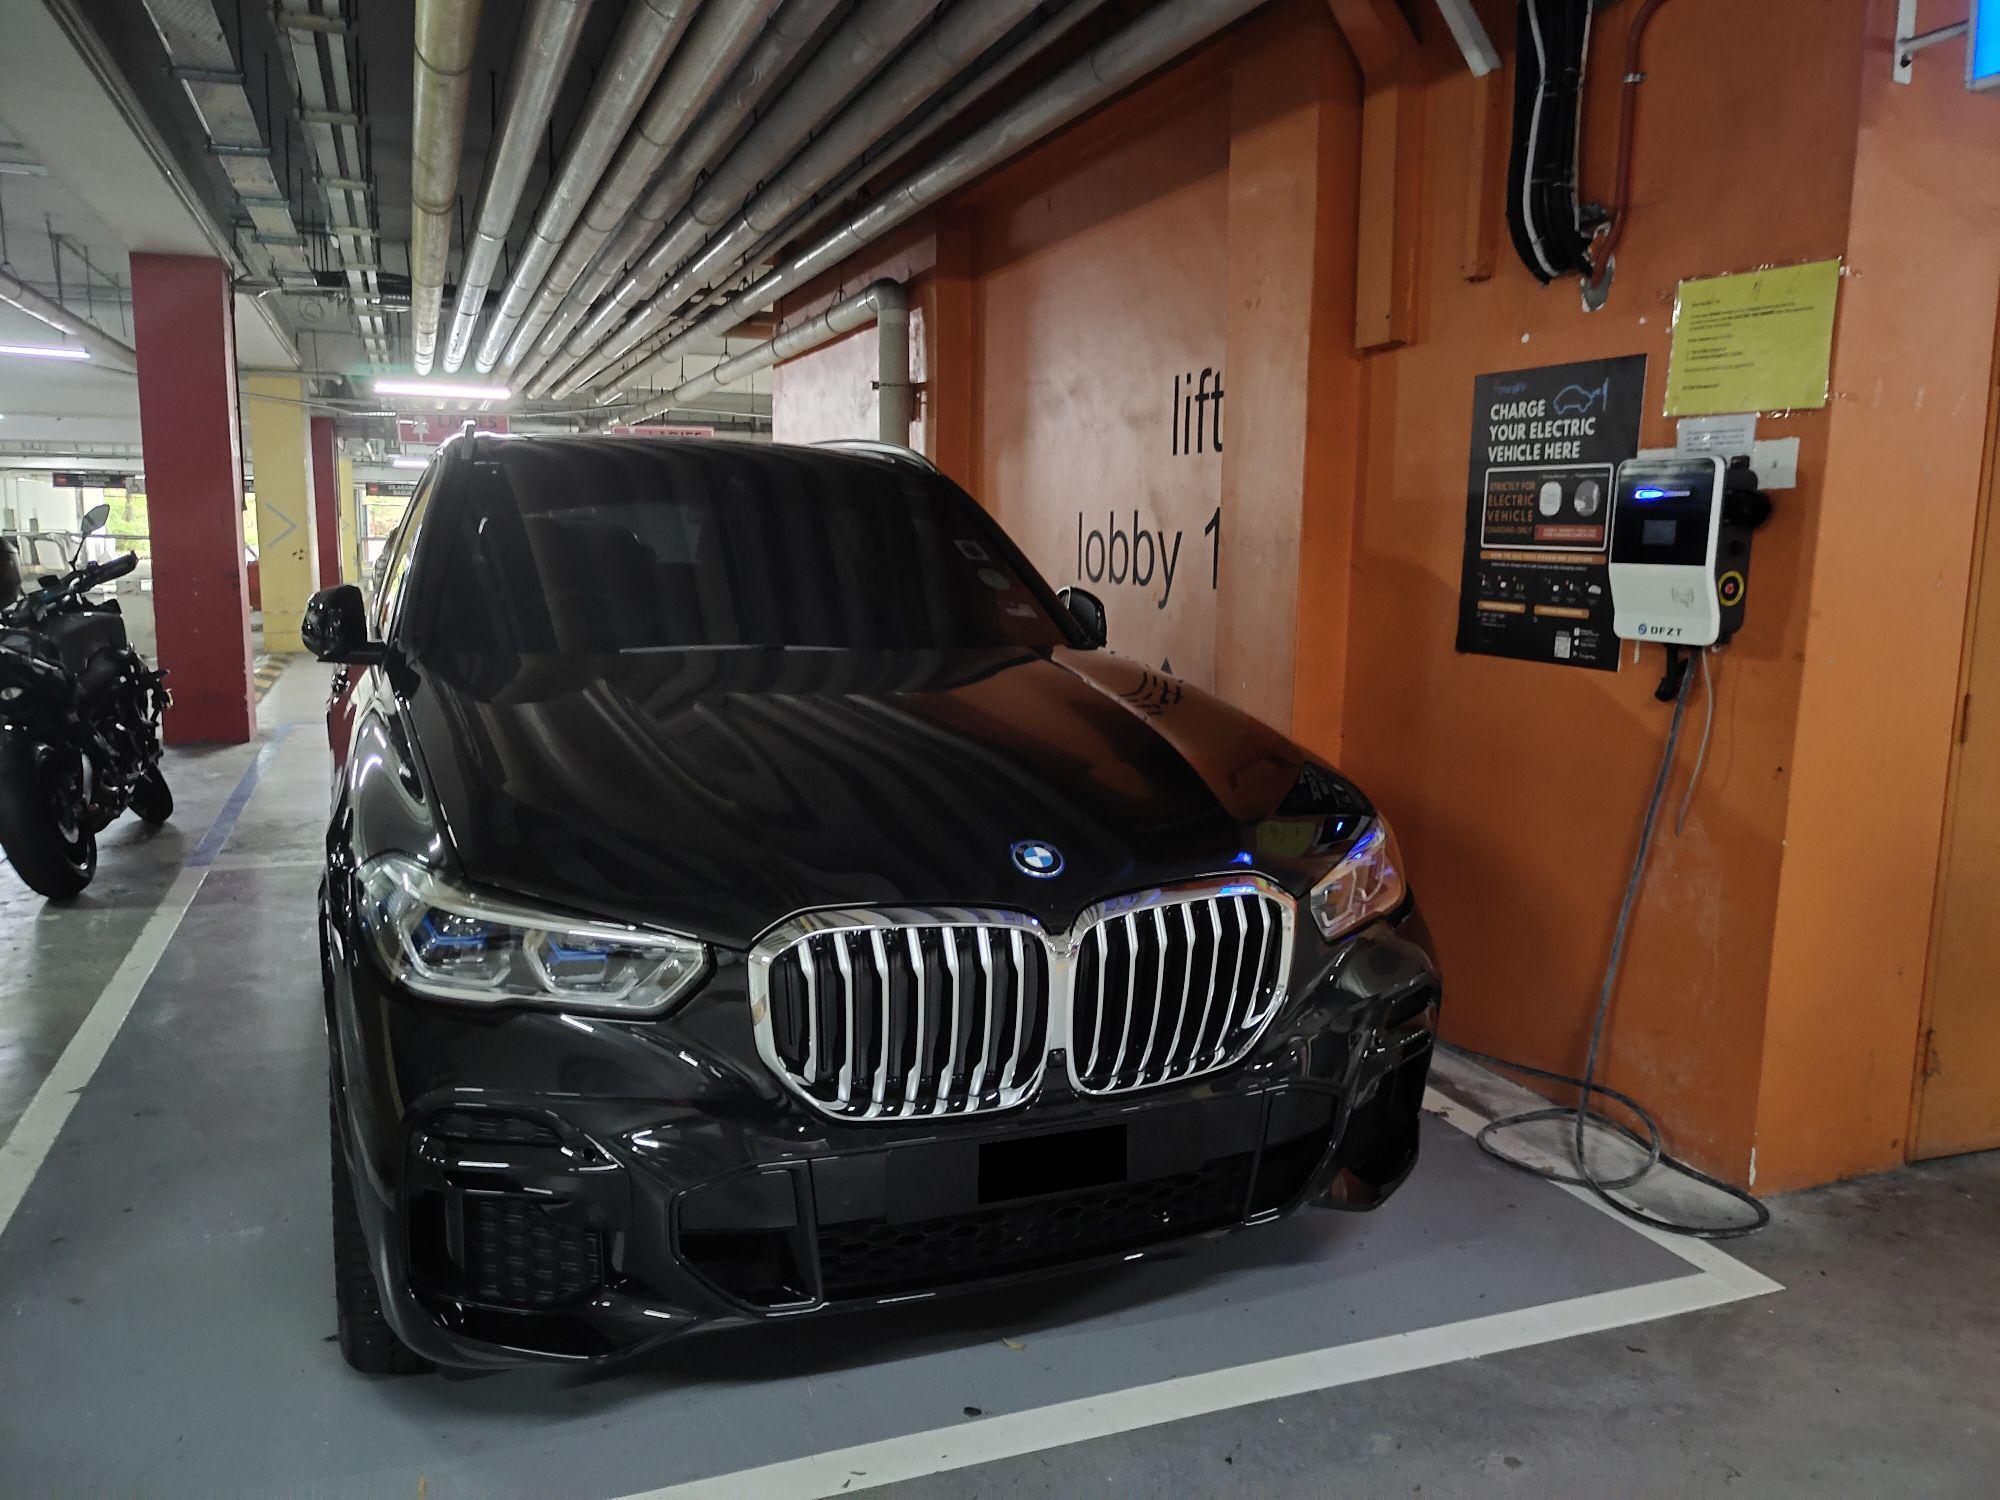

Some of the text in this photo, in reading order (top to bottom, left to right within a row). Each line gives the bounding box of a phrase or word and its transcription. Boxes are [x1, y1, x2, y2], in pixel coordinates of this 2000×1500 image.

[1172, 367, 1224, 456] lift
[1490, 399, 1545, 421] CHARGE
[1489, 416, 1596, 442] YOUR ELECTRIC
[1488, 440, 1580, 462] VEHICLE HERE
[1487, 493, 1534, 506] ELECTRIC
[1486, 510, 1534, 522] VEHICLE
[1077, 506, 1221, 610] lobby 1
